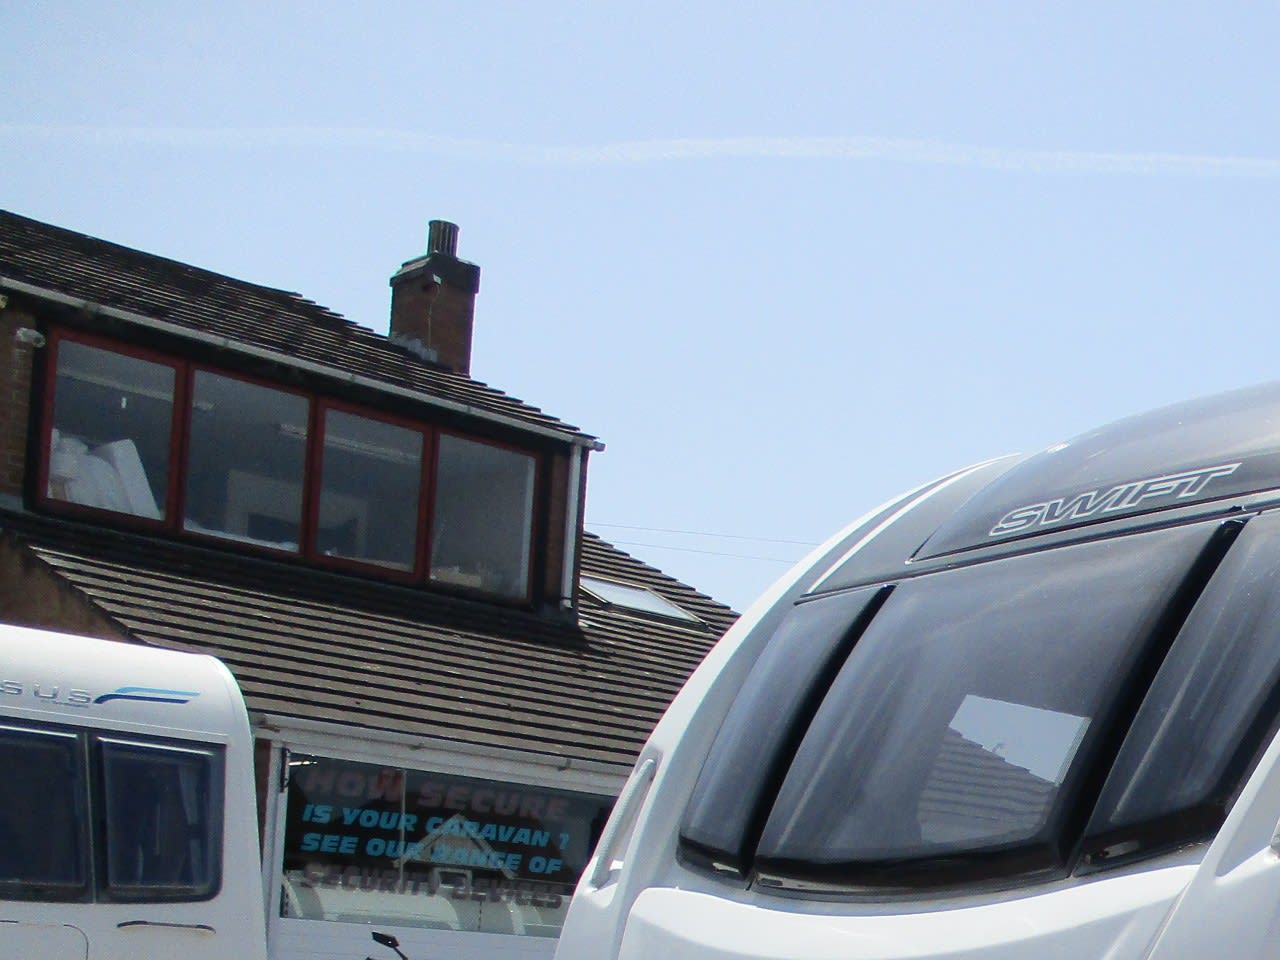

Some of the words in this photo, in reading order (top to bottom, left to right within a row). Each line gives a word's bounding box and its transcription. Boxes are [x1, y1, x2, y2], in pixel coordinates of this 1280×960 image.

[989, 462, 1243, 537] SWIFT
[303, 766, 405, 800] HOW
[417, 780, 569, 819] SECURE
[302, 804, 332, 823] IS
[342, 807, 418, 831] YOUR
[426, 816, 549, 848] CARAVAN
[301, 833, 358, 854] SEE
[366, 838, 424, 859] OUR
[431, 848, 520, 872] RANGE
[528, 855, 563, 875] OF
